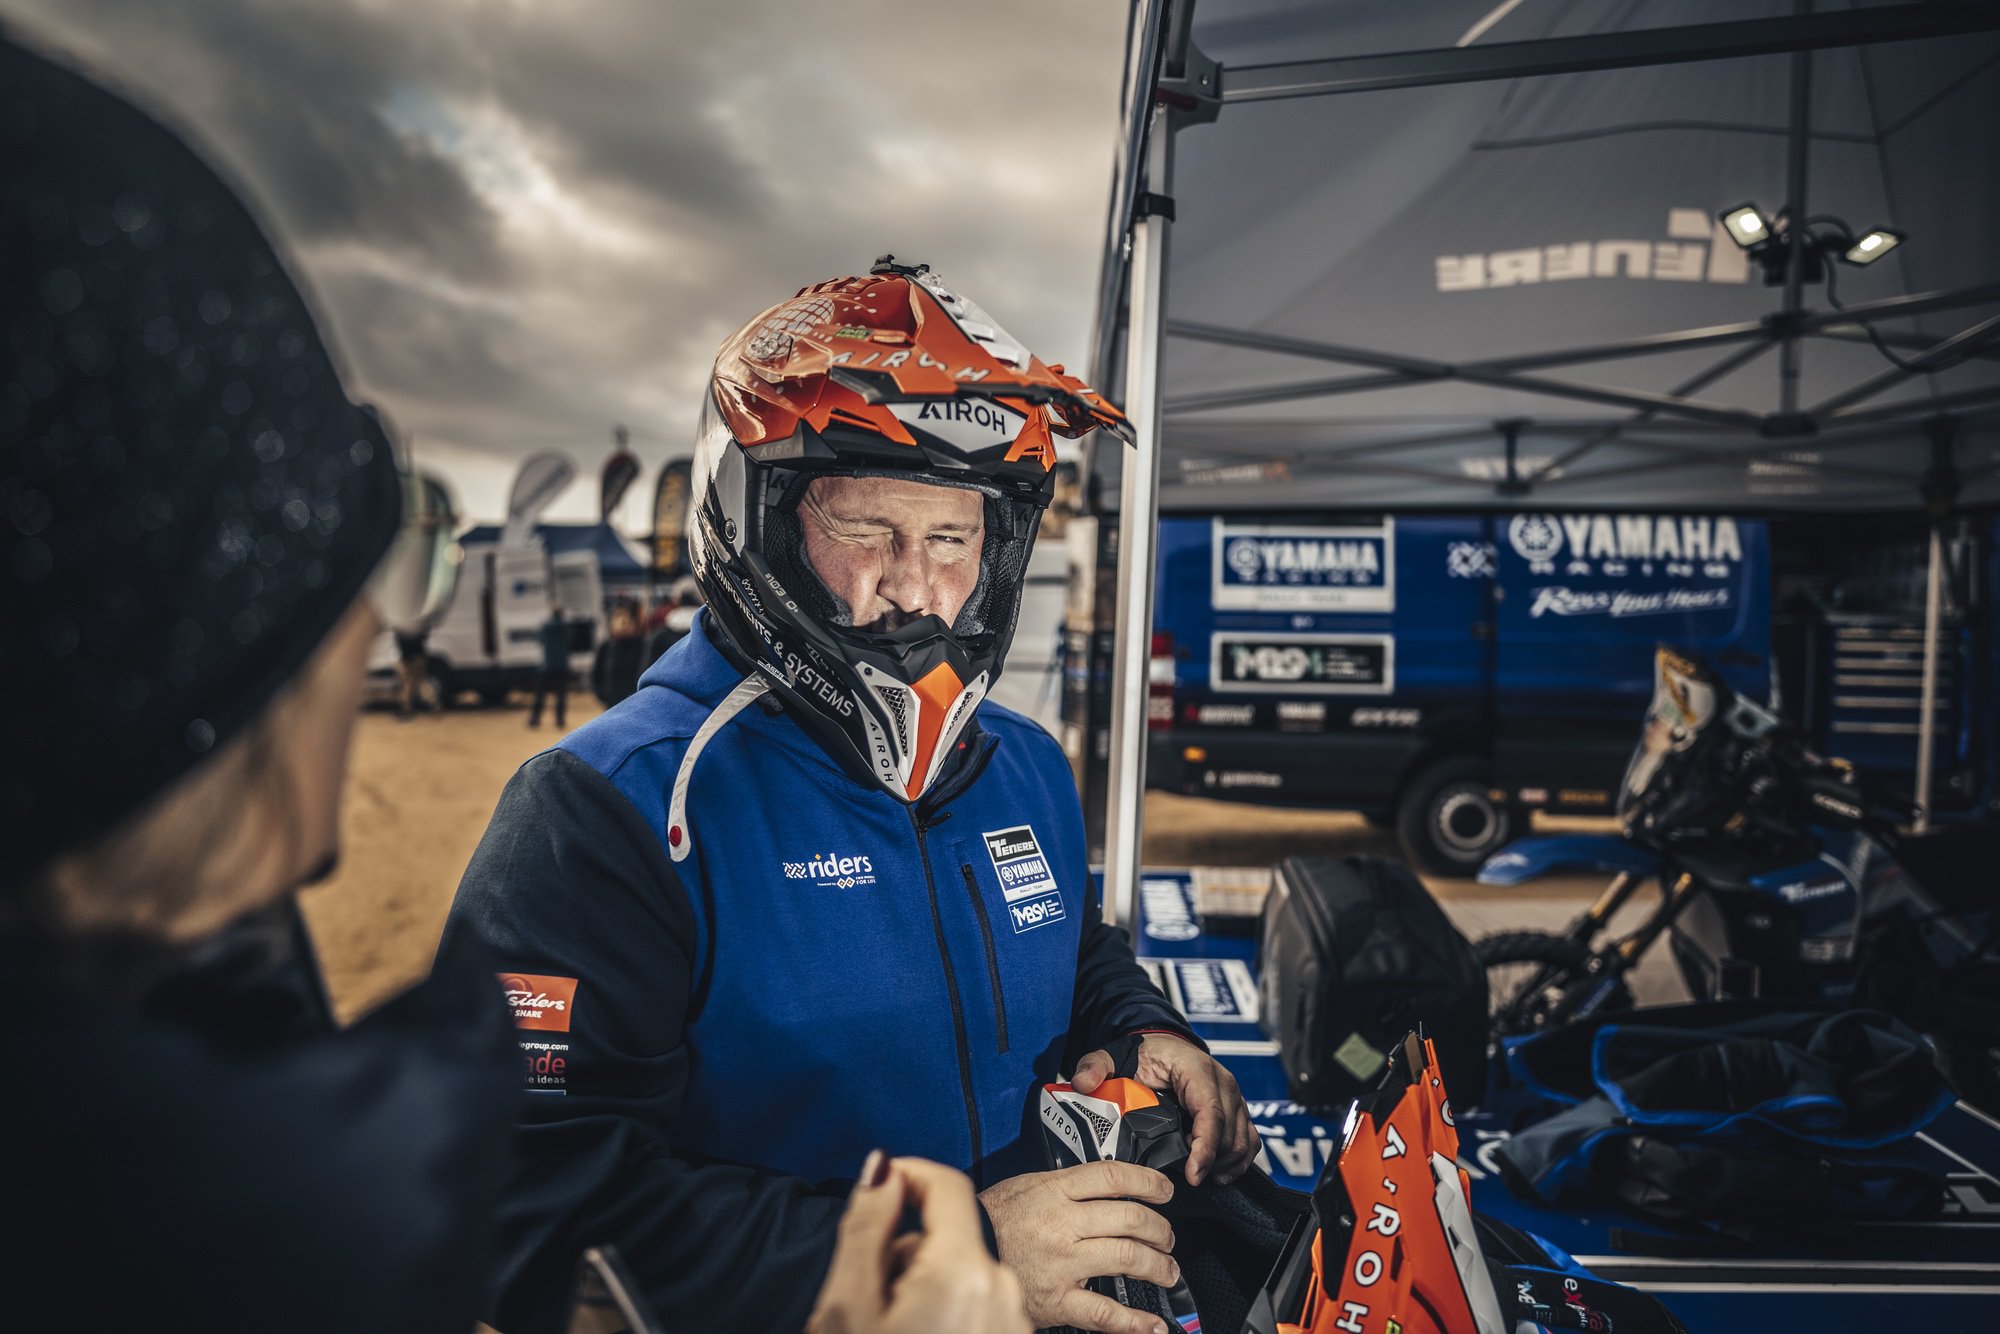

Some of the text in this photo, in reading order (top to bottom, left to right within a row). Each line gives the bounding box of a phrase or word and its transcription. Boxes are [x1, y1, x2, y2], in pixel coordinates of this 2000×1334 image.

[918, 400, 1006, 435] AIROH
[1561, 515, 1742, 561] YAMAHA
[1260, 540, 1379, 574] YAMAHA
[773, 641, 784, 659] &
[786, 652, 855, 717] SYSTEMS
[869, 721, 894, 782] AIROH
[808, 853, 873, 878] riders
[1009, 873, 1046, 887] RACING
[1010, 859, 1046, 879] YAMAHA
[514, 1009, 543, 1019] SHARE
[537, 1075, 566, 1085] ideas
[1043, 1106, 1079, 1144] AIROH
